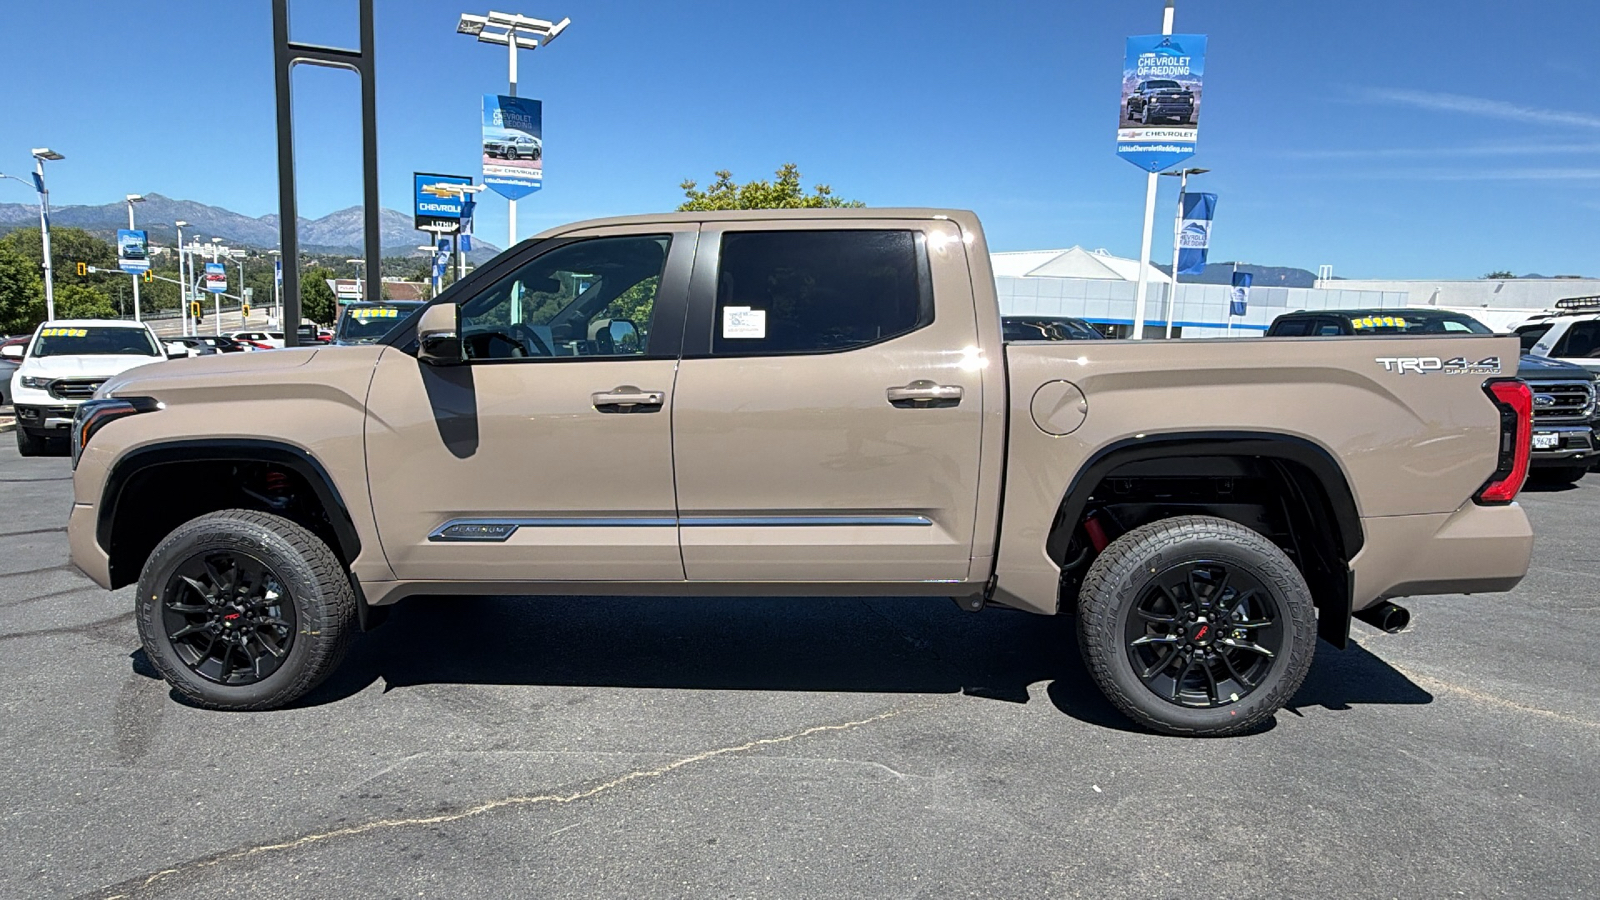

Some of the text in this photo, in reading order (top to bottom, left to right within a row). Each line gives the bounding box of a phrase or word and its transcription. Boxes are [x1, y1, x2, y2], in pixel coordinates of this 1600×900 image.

[1137, 57, 1191, 67] CHEVROLET
[1137, 66, 1190, 76] OF REDDING
[492, 112, 532, 123] CHEVROLET
[504, 119, 533, 129] REDDING
[1118, 144, 1193, 153] LithiaChevroletRedding.com
[504, 168, 540, 176] CHEVROLET
[419, 202, 462, 213] CHEVROLE
[1375, 357, 1443, 375] TRD
[451, 526, 504, 534] PLATINUM
